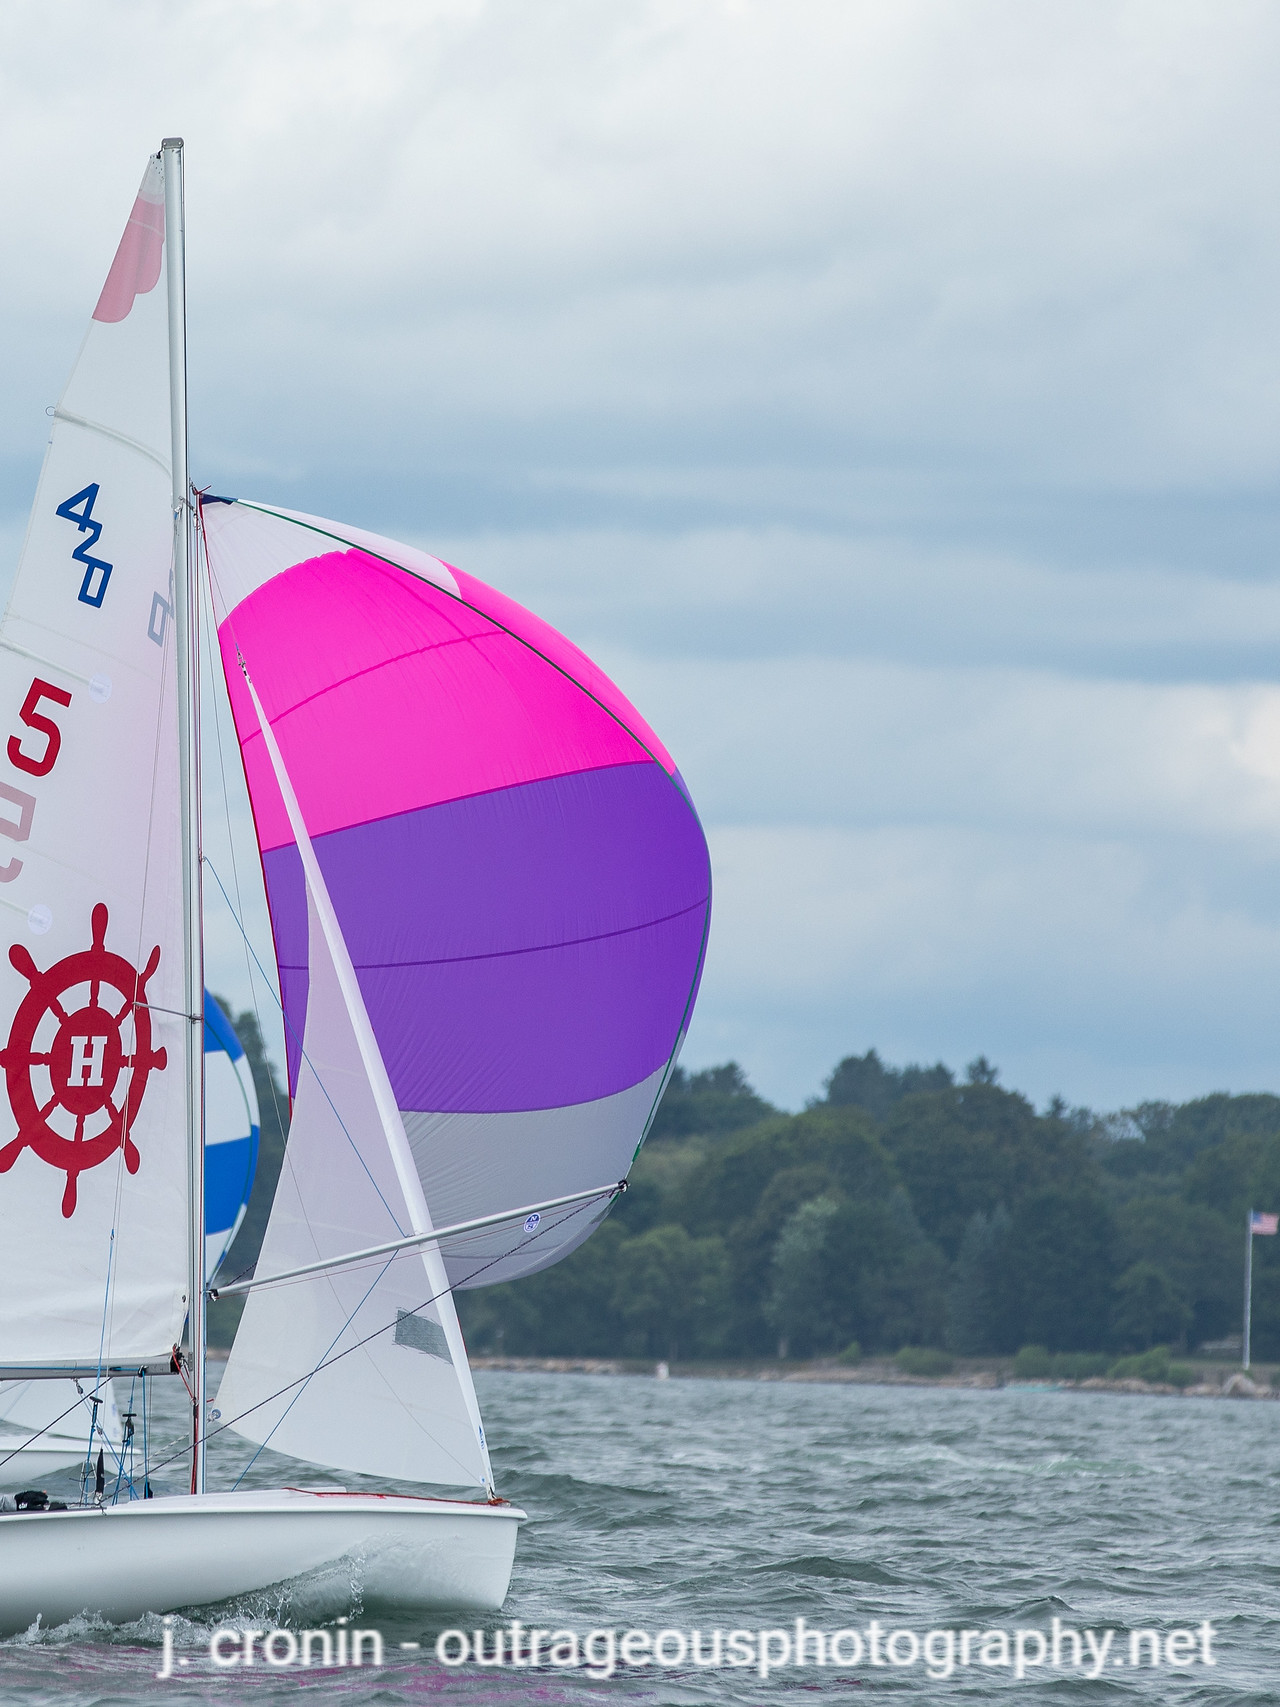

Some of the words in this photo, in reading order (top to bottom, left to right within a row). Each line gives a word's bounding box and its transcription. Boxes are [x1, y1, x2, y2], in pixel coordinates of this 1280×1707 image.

[56, 483, 113, 608] 420
[7, 677, 72, 777] 5
[67, 1036, 108, 1086] H
